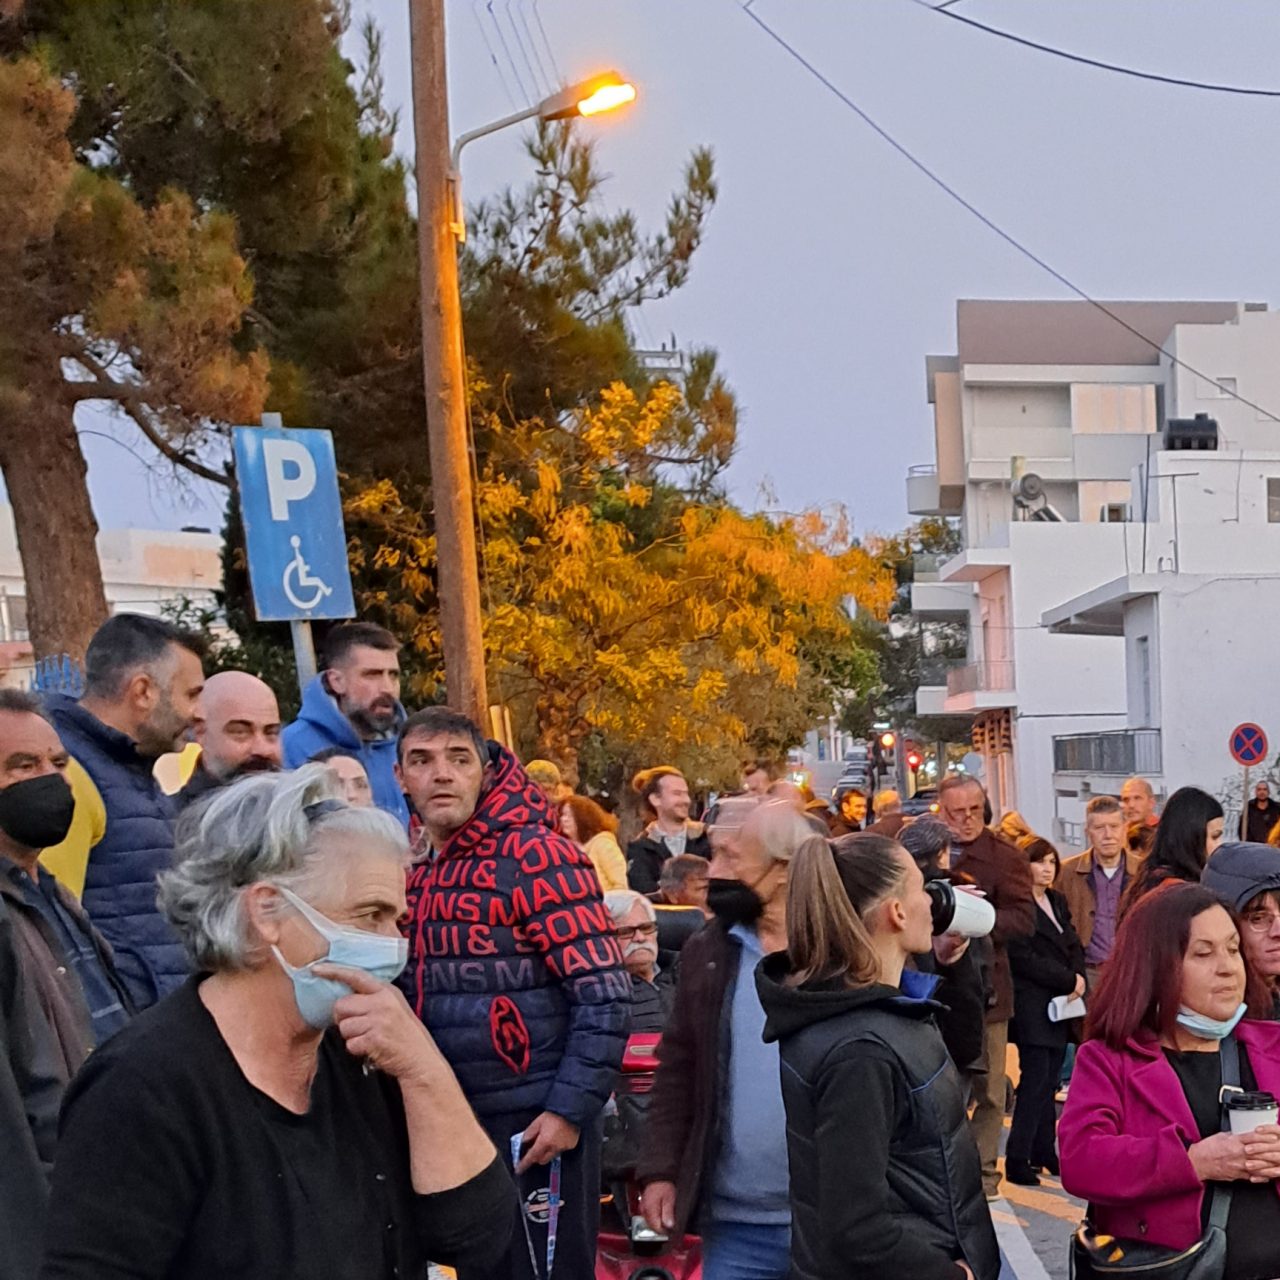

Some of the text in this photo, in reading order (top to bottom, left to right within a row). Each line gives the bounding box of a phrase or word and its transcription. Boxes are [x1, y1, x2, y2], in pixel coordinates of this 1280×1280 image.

[262, 438, 317, 521] P
[472, 860, 497, 889] &
[467, 924, 499, 955] &
